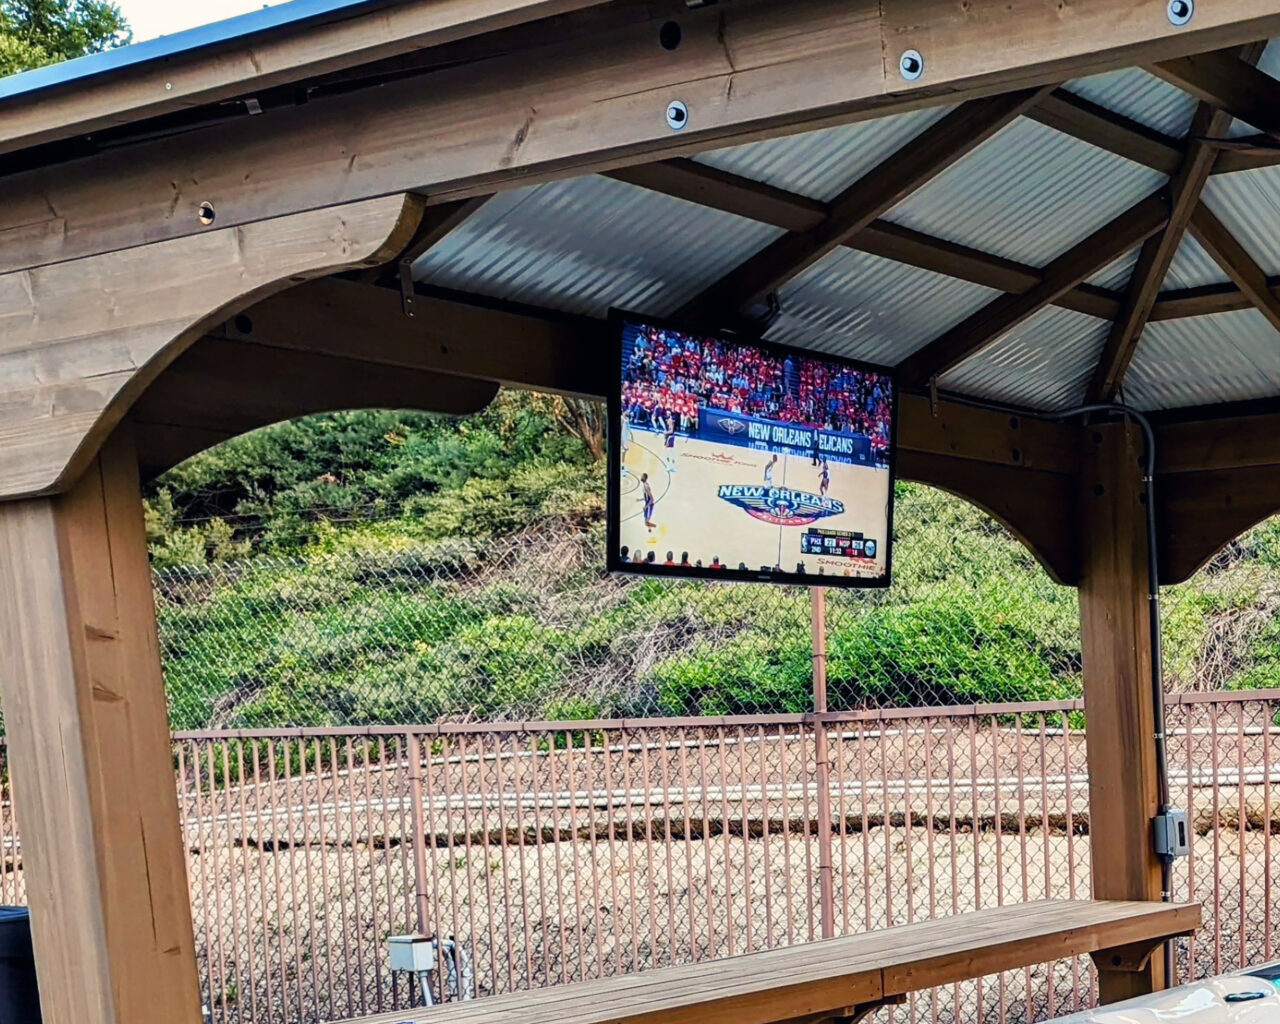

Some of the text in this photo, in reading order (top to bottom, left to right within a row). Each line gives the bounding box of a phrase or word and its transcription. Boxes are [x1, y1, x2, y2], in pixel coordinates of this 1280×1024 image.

[748, 421, 853, 454] NEW ORLEANS ELICANS
[719, 485, 844, 512] NEW ORLEANS
[816, 557, 876, 571] SMOOTHIE
